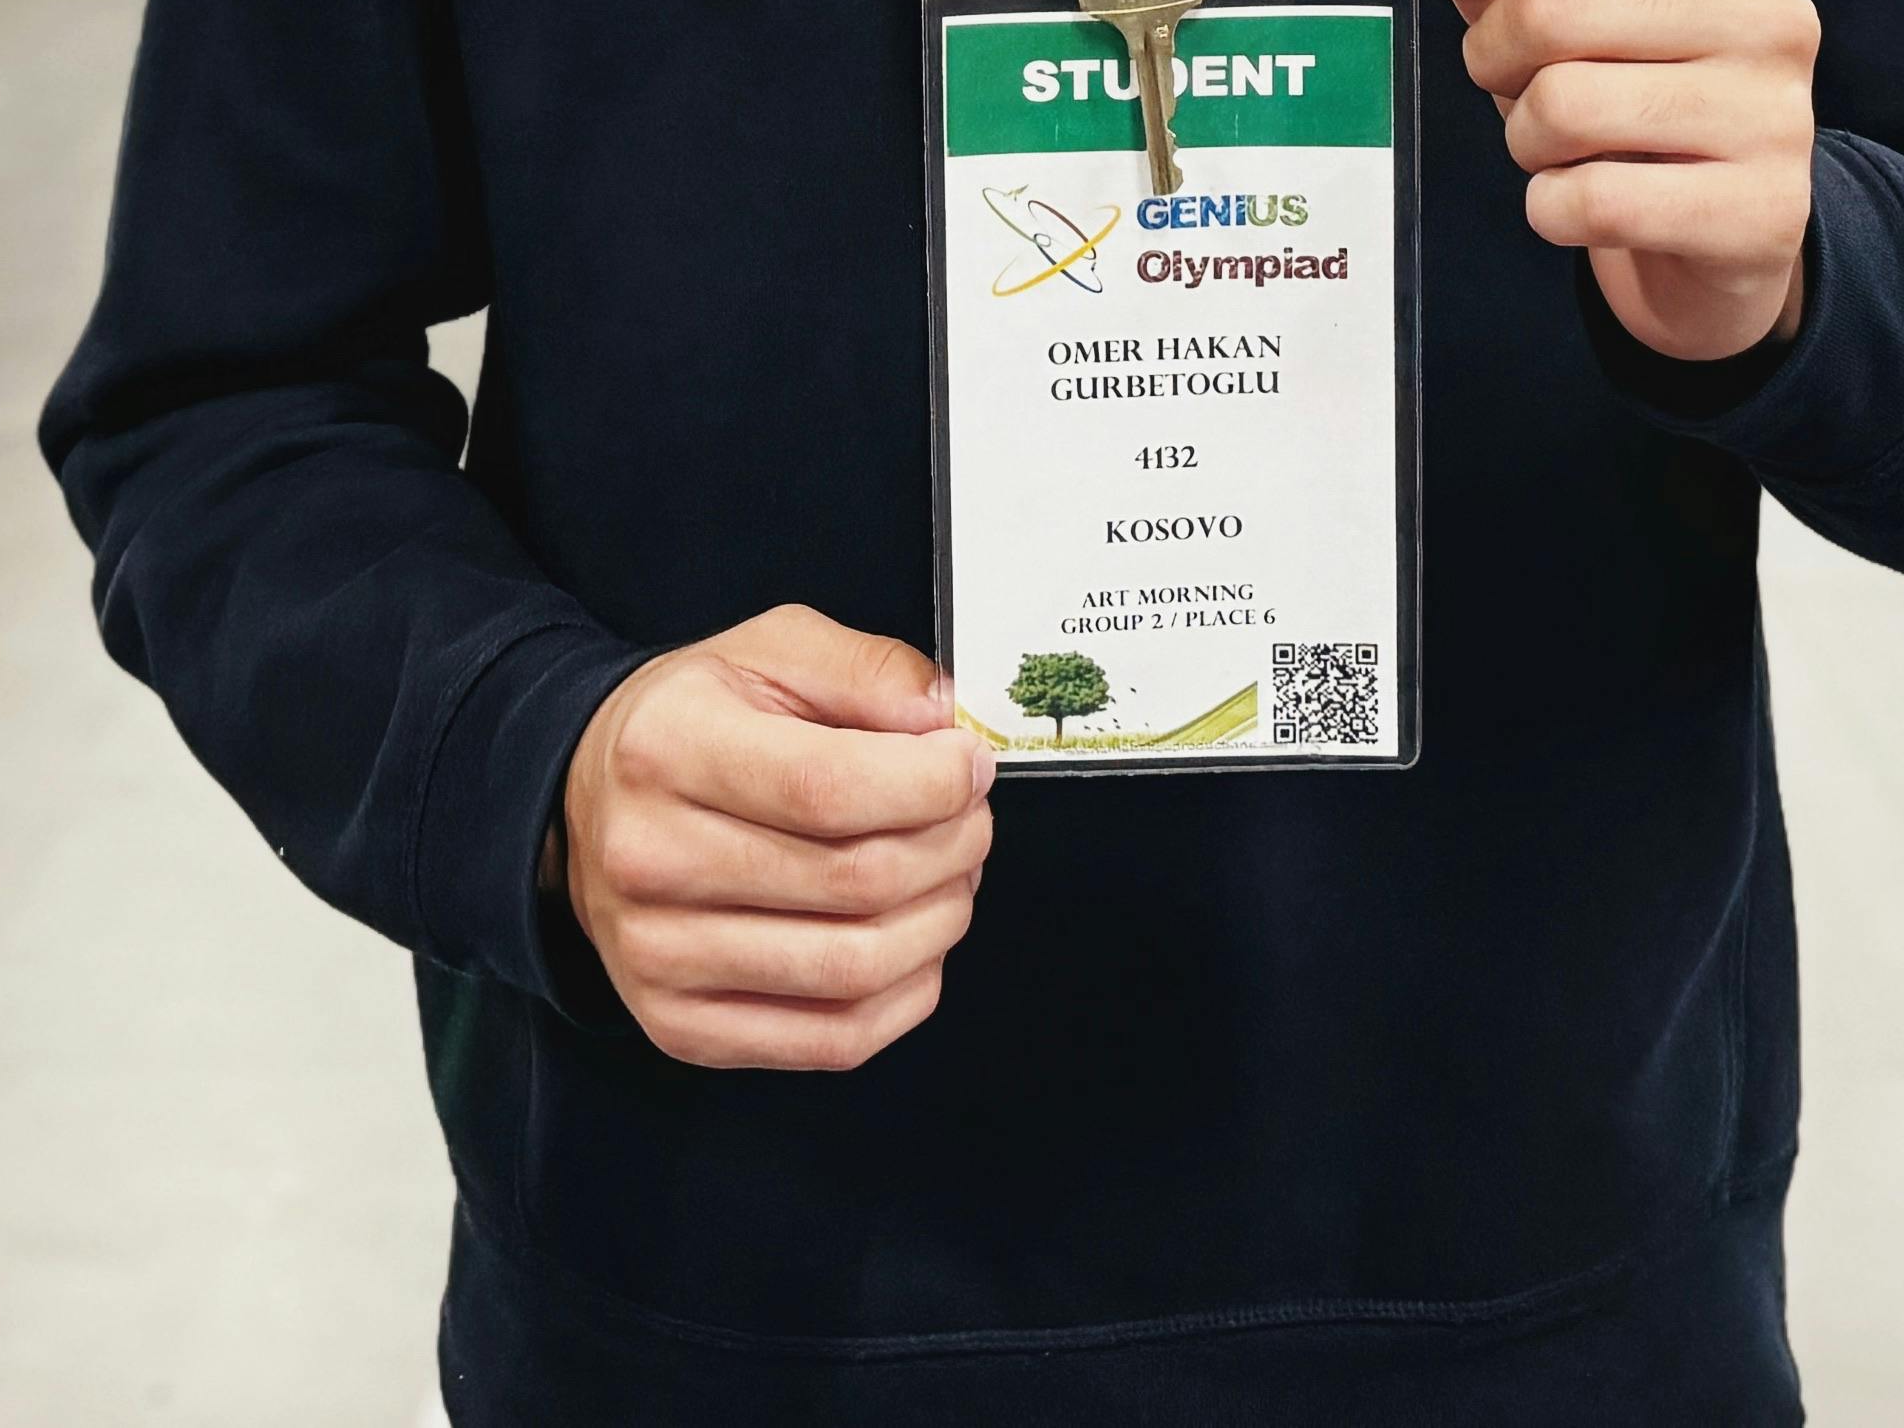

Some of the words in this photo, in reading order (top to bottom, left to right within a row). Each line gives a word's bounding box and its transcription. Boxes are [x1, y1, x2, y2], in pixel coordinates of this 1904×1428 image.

[1136, 194, 1309, 230] GENIUS
[1136, 247, 1348, 289] Olympiad
[1047, 339, 1143, 365] OMER
[1157, 335, 1282, 361] HAKAN
[1051, 371, 1280, 401] GURBETOGLU
[1134, 445, 1199, 469] 4132
[1106, 515, 1243, 543] KOSOVO
[1082, 589, 1130, 609] ART
[1137, 583, 1254, 606] MORNING
[1061, 614, 1144, 635] GROUP
[1151, 613, 1164, 630] 2
[1170, 611, 1178, 628] /
[1186, 608, 1257, 628] PLACE
[1263, 607, 1276, 625] 6
